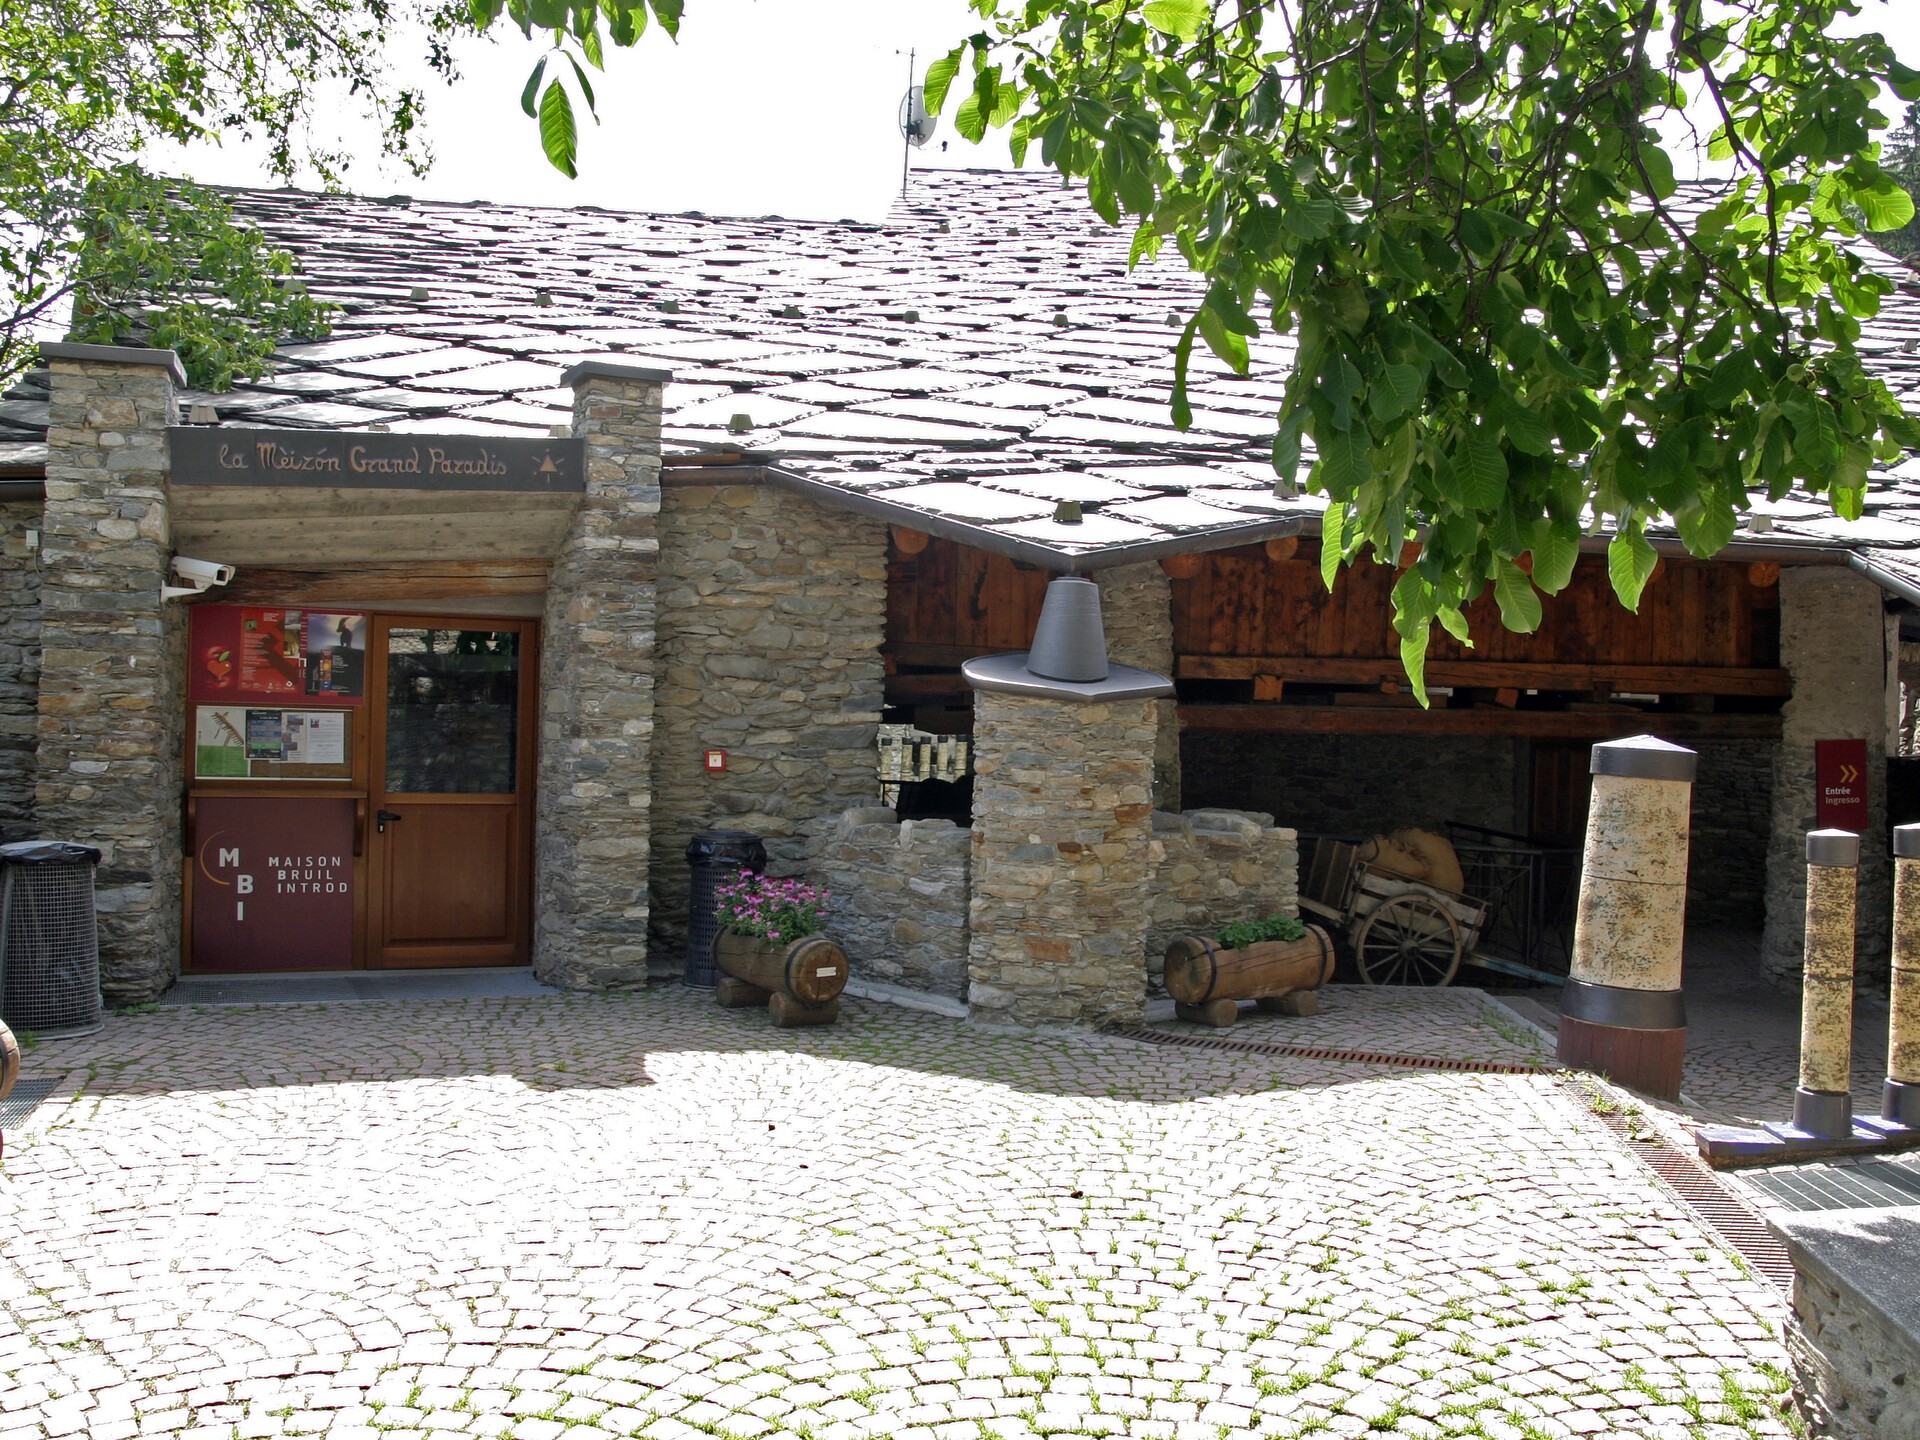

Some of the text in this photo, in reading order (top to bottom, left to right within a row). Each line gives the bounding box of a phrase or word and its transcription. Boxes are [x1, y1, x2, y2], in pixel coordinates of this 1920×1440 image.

[350, 446, 421, 474] Grand
[428, 447, 508, 475] Paradis
[1825, 786, 1851, 795] Entrée
[1825, 797, 1860, 806] Ingresso
[268, 856, 341, 867] MAISON
[278, 869, 333, 880] BRUIL
[277, 882, 348, 893] INTROD
